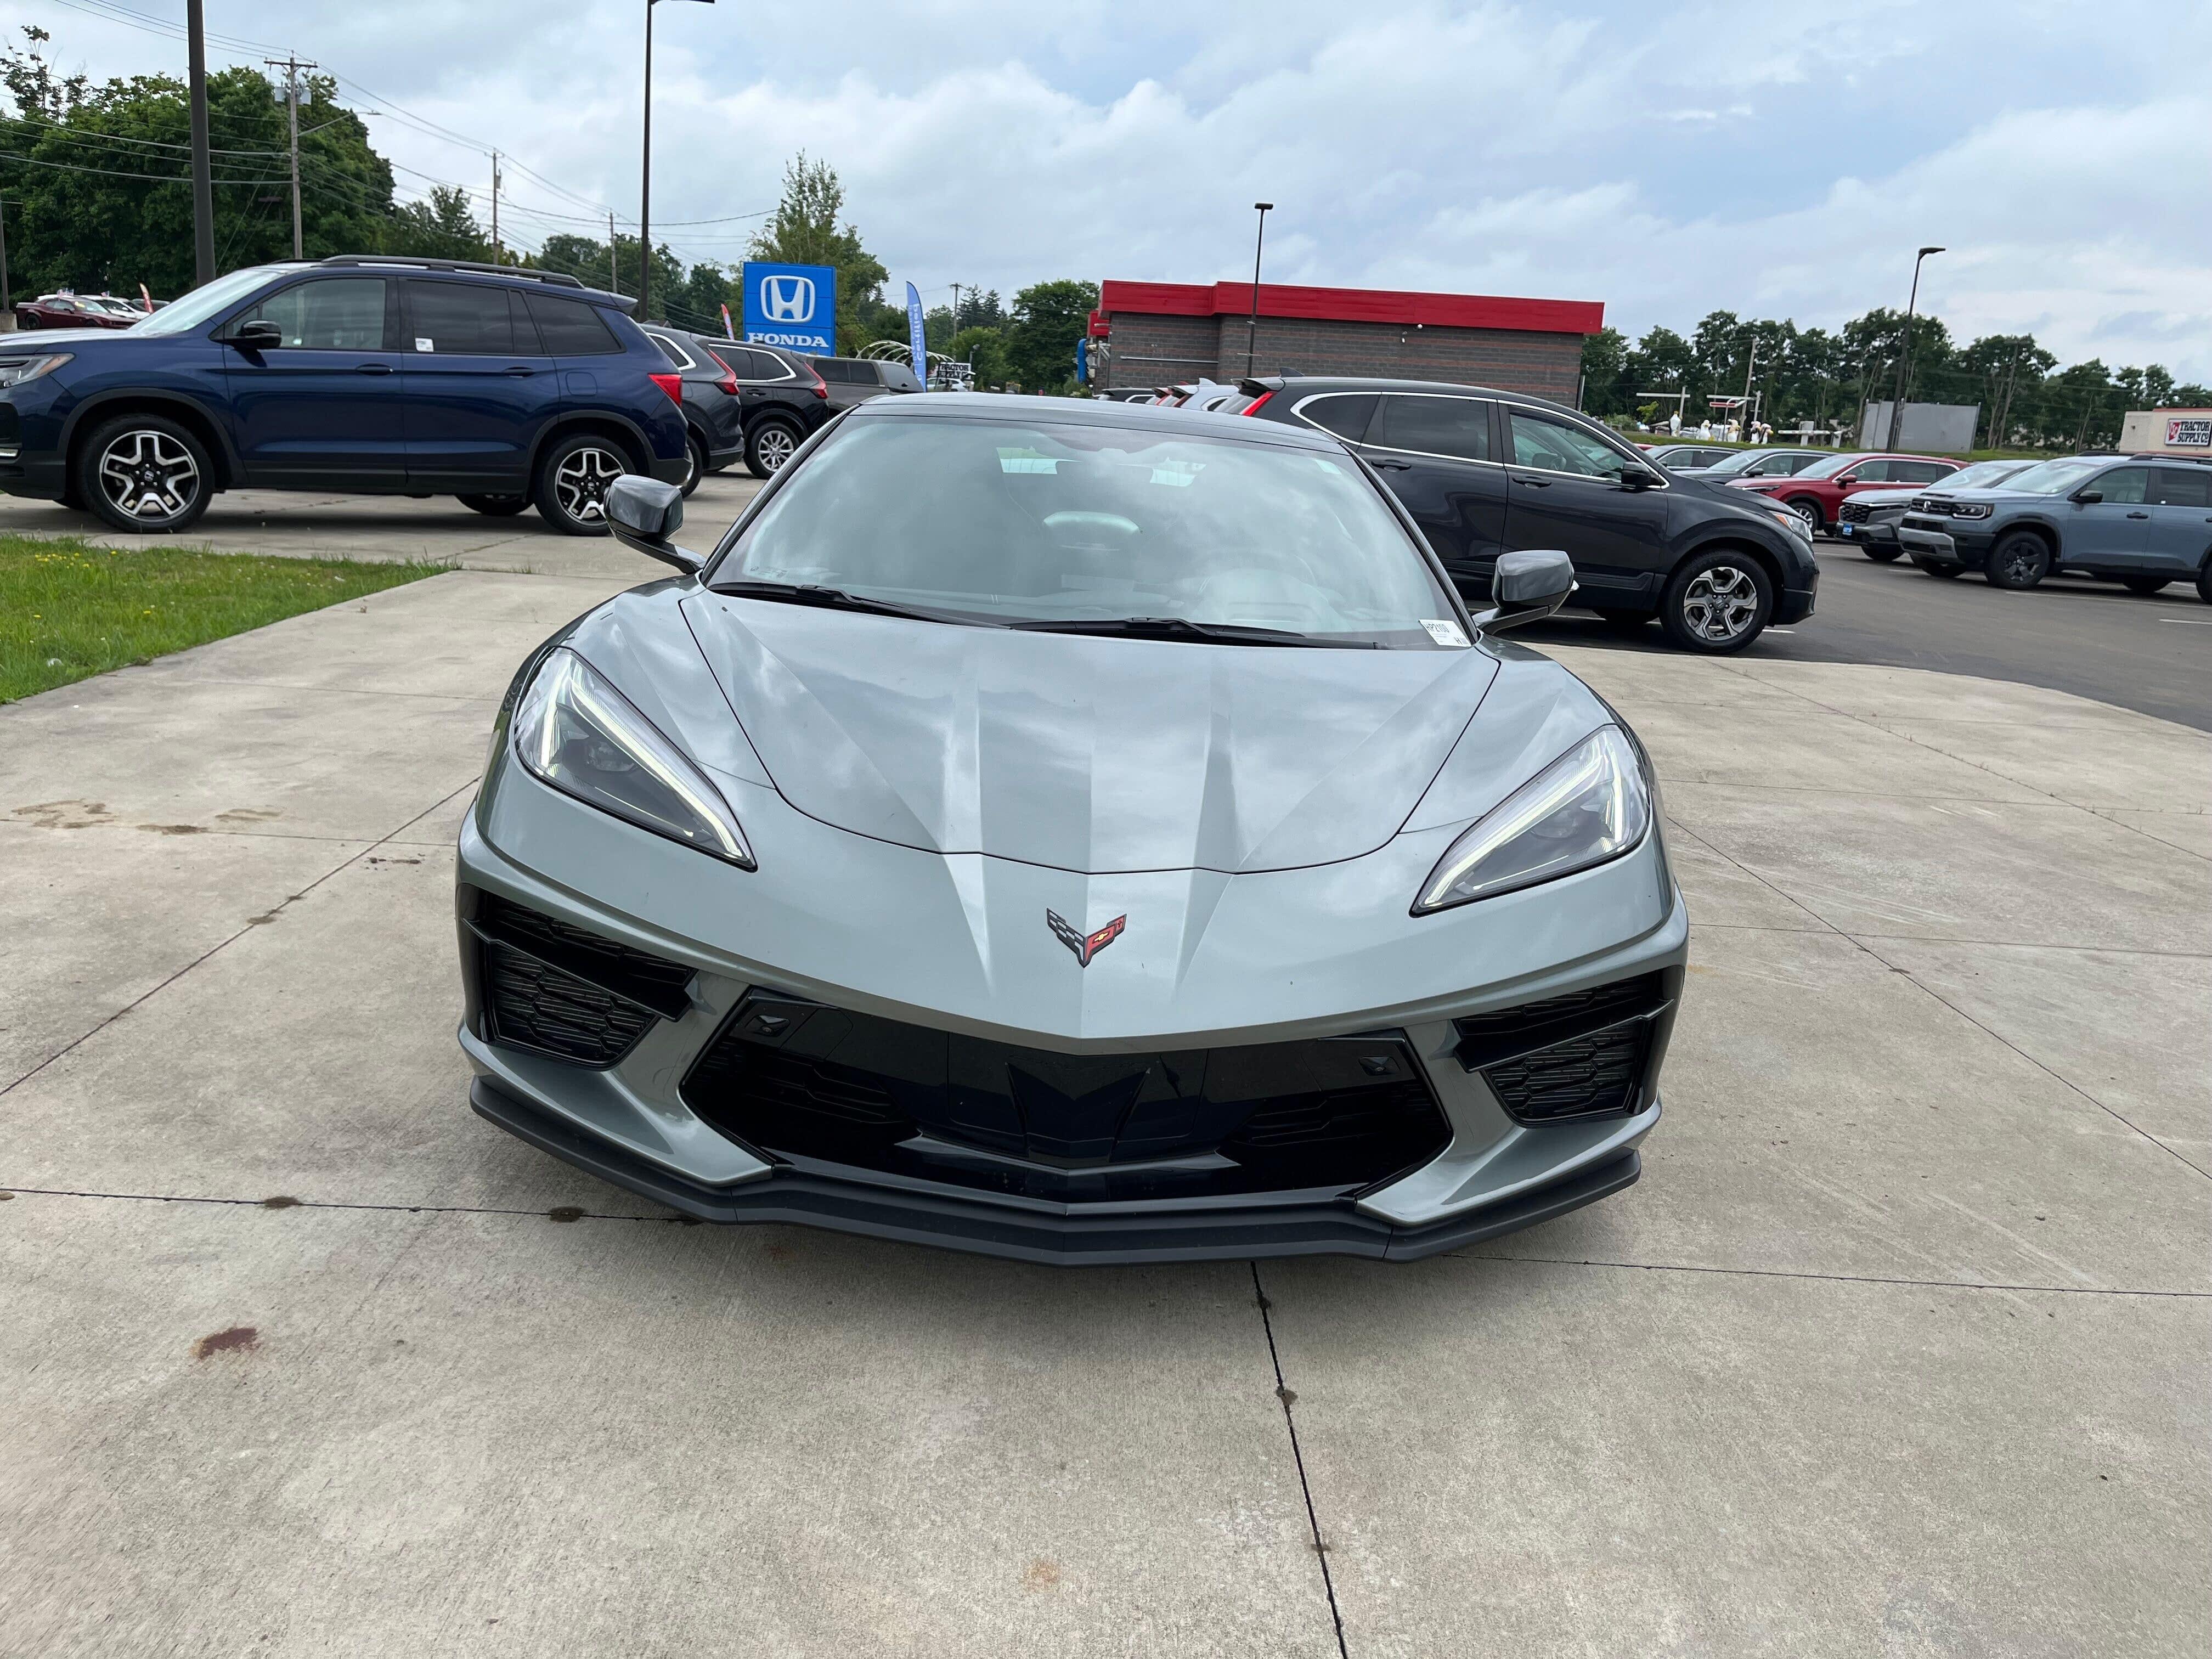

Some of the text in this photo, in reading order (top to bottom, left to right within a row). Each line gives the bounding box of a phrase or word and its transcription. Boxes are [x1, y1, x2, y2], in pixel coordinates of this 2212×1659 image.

[747, 332, 829, 347] HONDA
[2180, 421, 2210, 431] TRACTOR
[2177, 432, 2201, 442] SUPPLY
